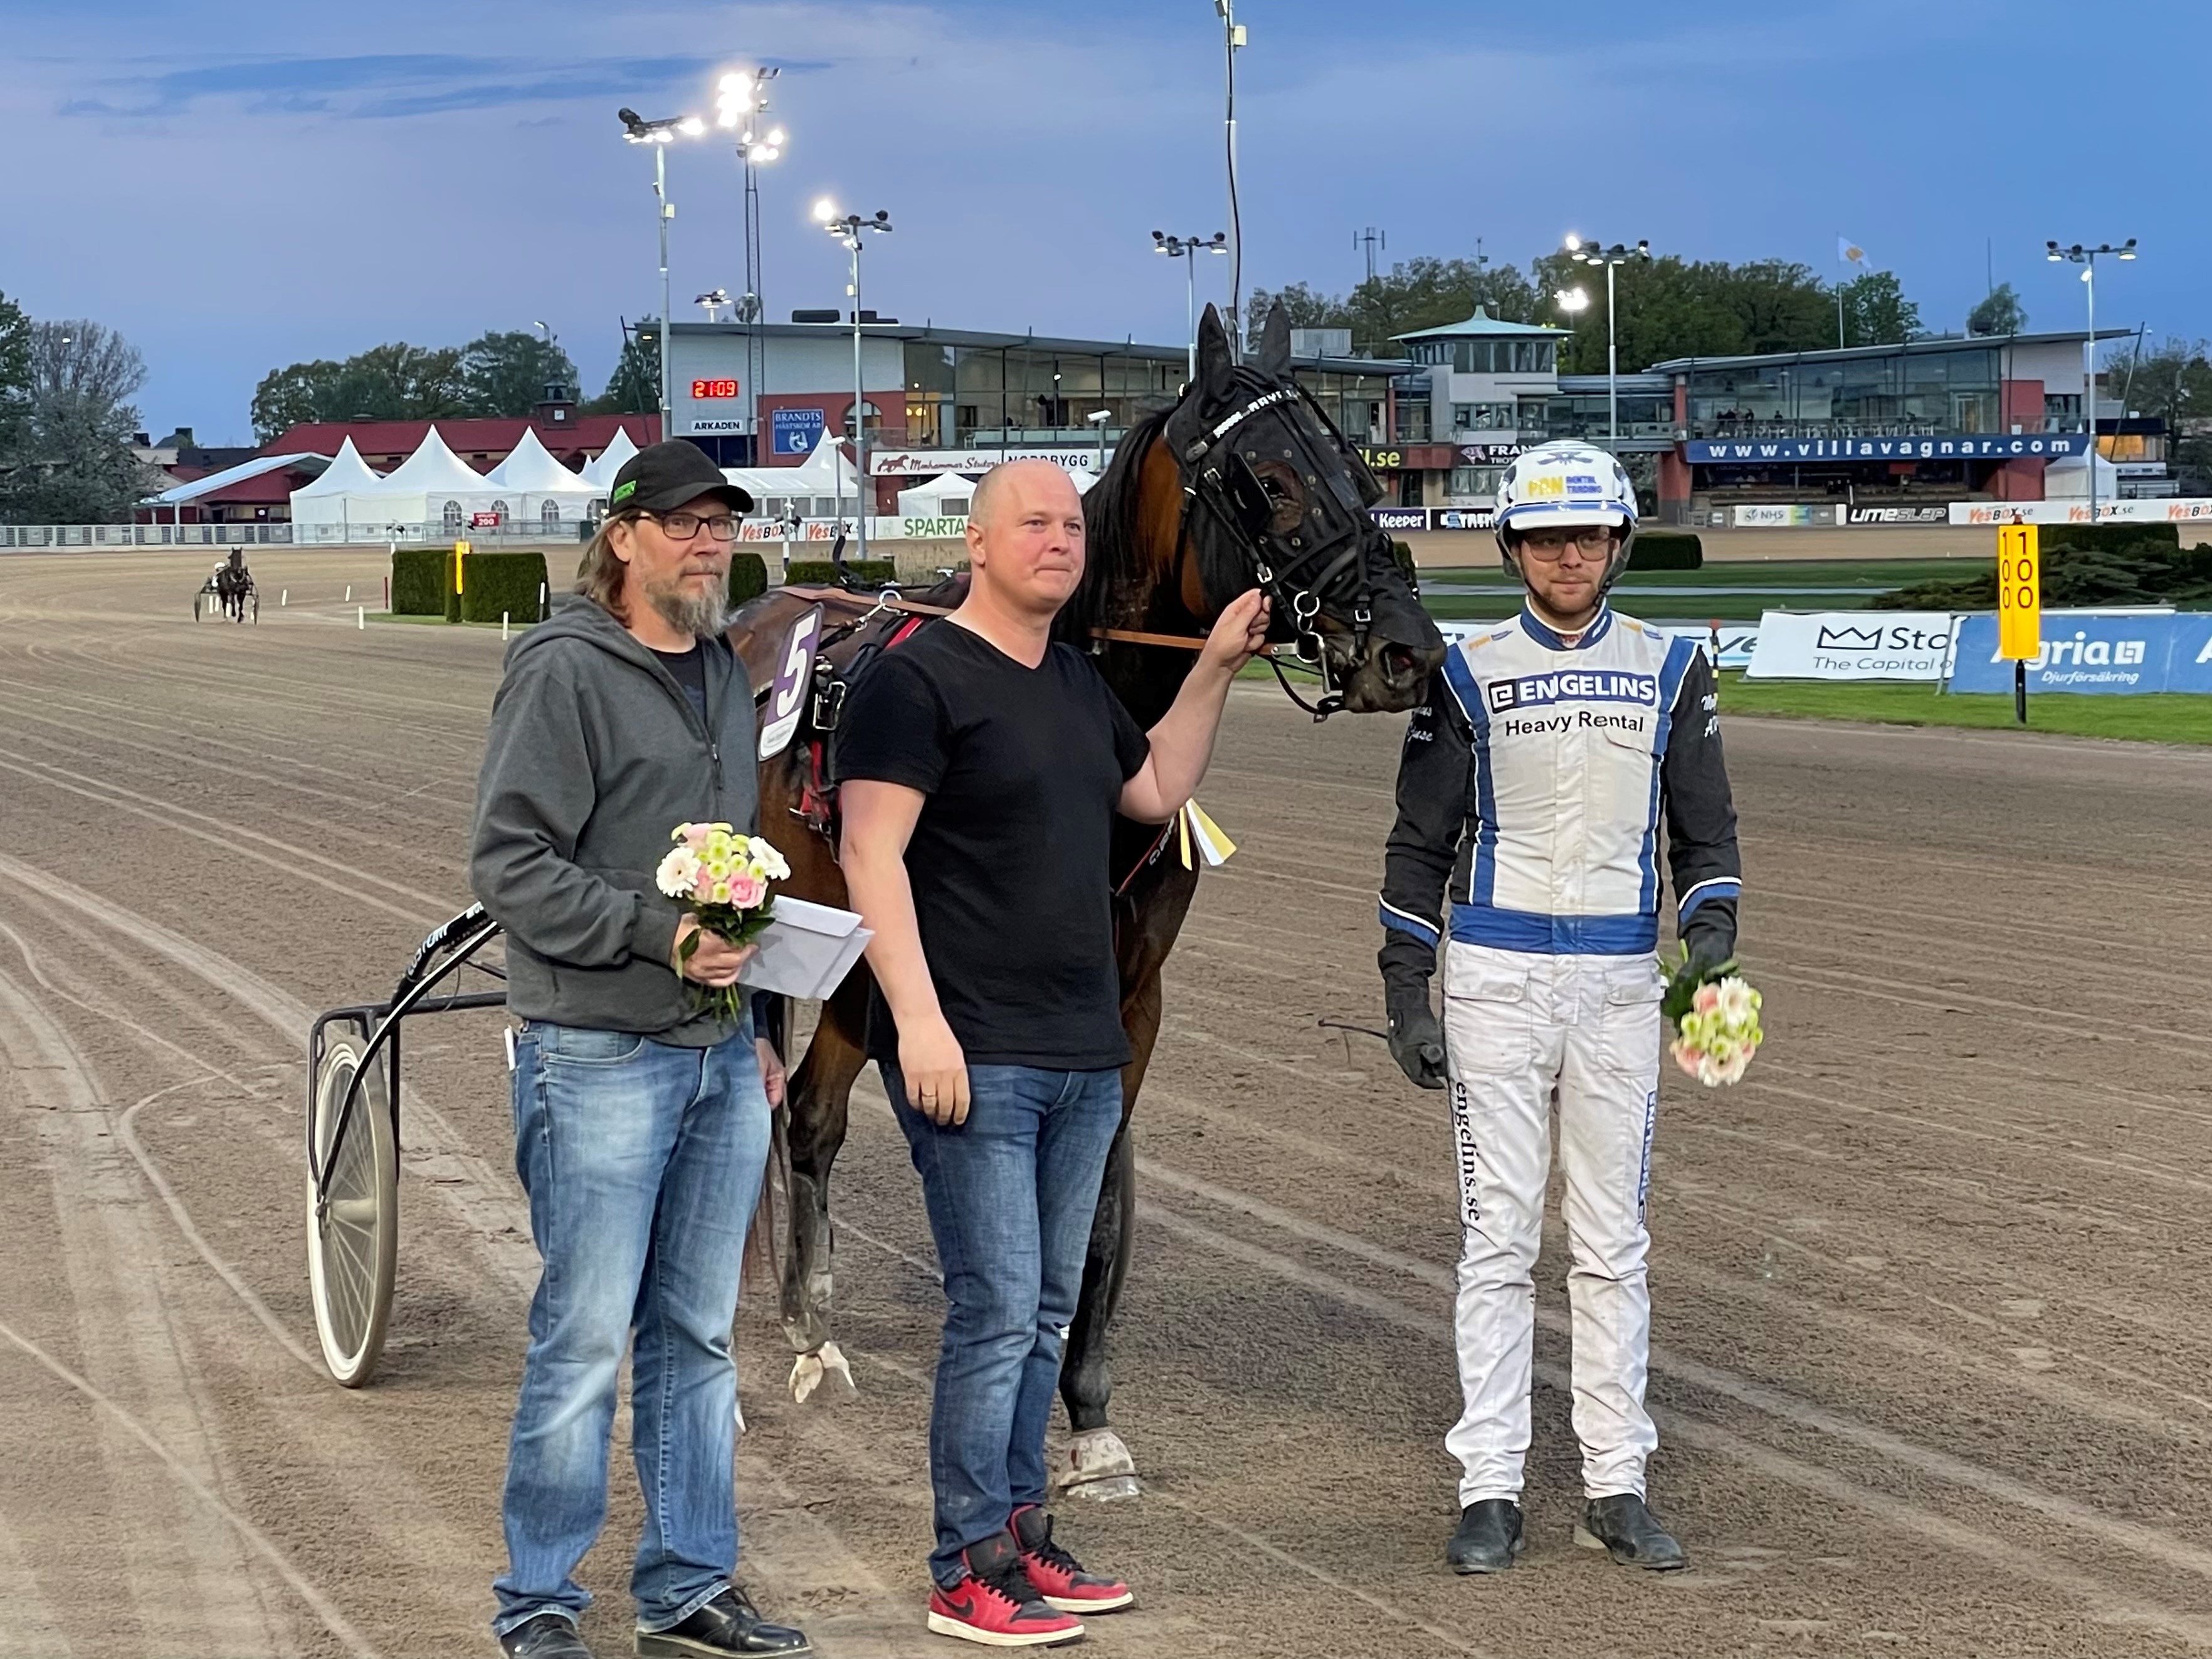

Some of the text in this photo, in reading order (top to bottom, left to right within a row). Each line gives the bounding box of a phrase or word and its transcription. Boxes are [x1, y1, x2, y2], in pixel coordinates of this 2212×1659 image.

[694, 381, 736, 397] 21:09
[776, 413, 821, 422] BRANDTS
[693, 422, 740, 430] ARKADEN
[1709, 440, 2070, 458] www.villavagnar.com
[1380, 514, 1424, 527] Keeper
[1761, 510, 1784, 520] NHS
[777, 613, 816, 718] 5
[1813, 656, 1851, 670] The
[1856, 657, 1935, 672] Capital
[2041, 671, 2139, 685] Djurförsäkring
[1519, 674, 1654, 701] ENGELINS
[1506, 712, 1643, 736] Heavy Rental
[1455, 1082, 1480, 1221] engelins.se
